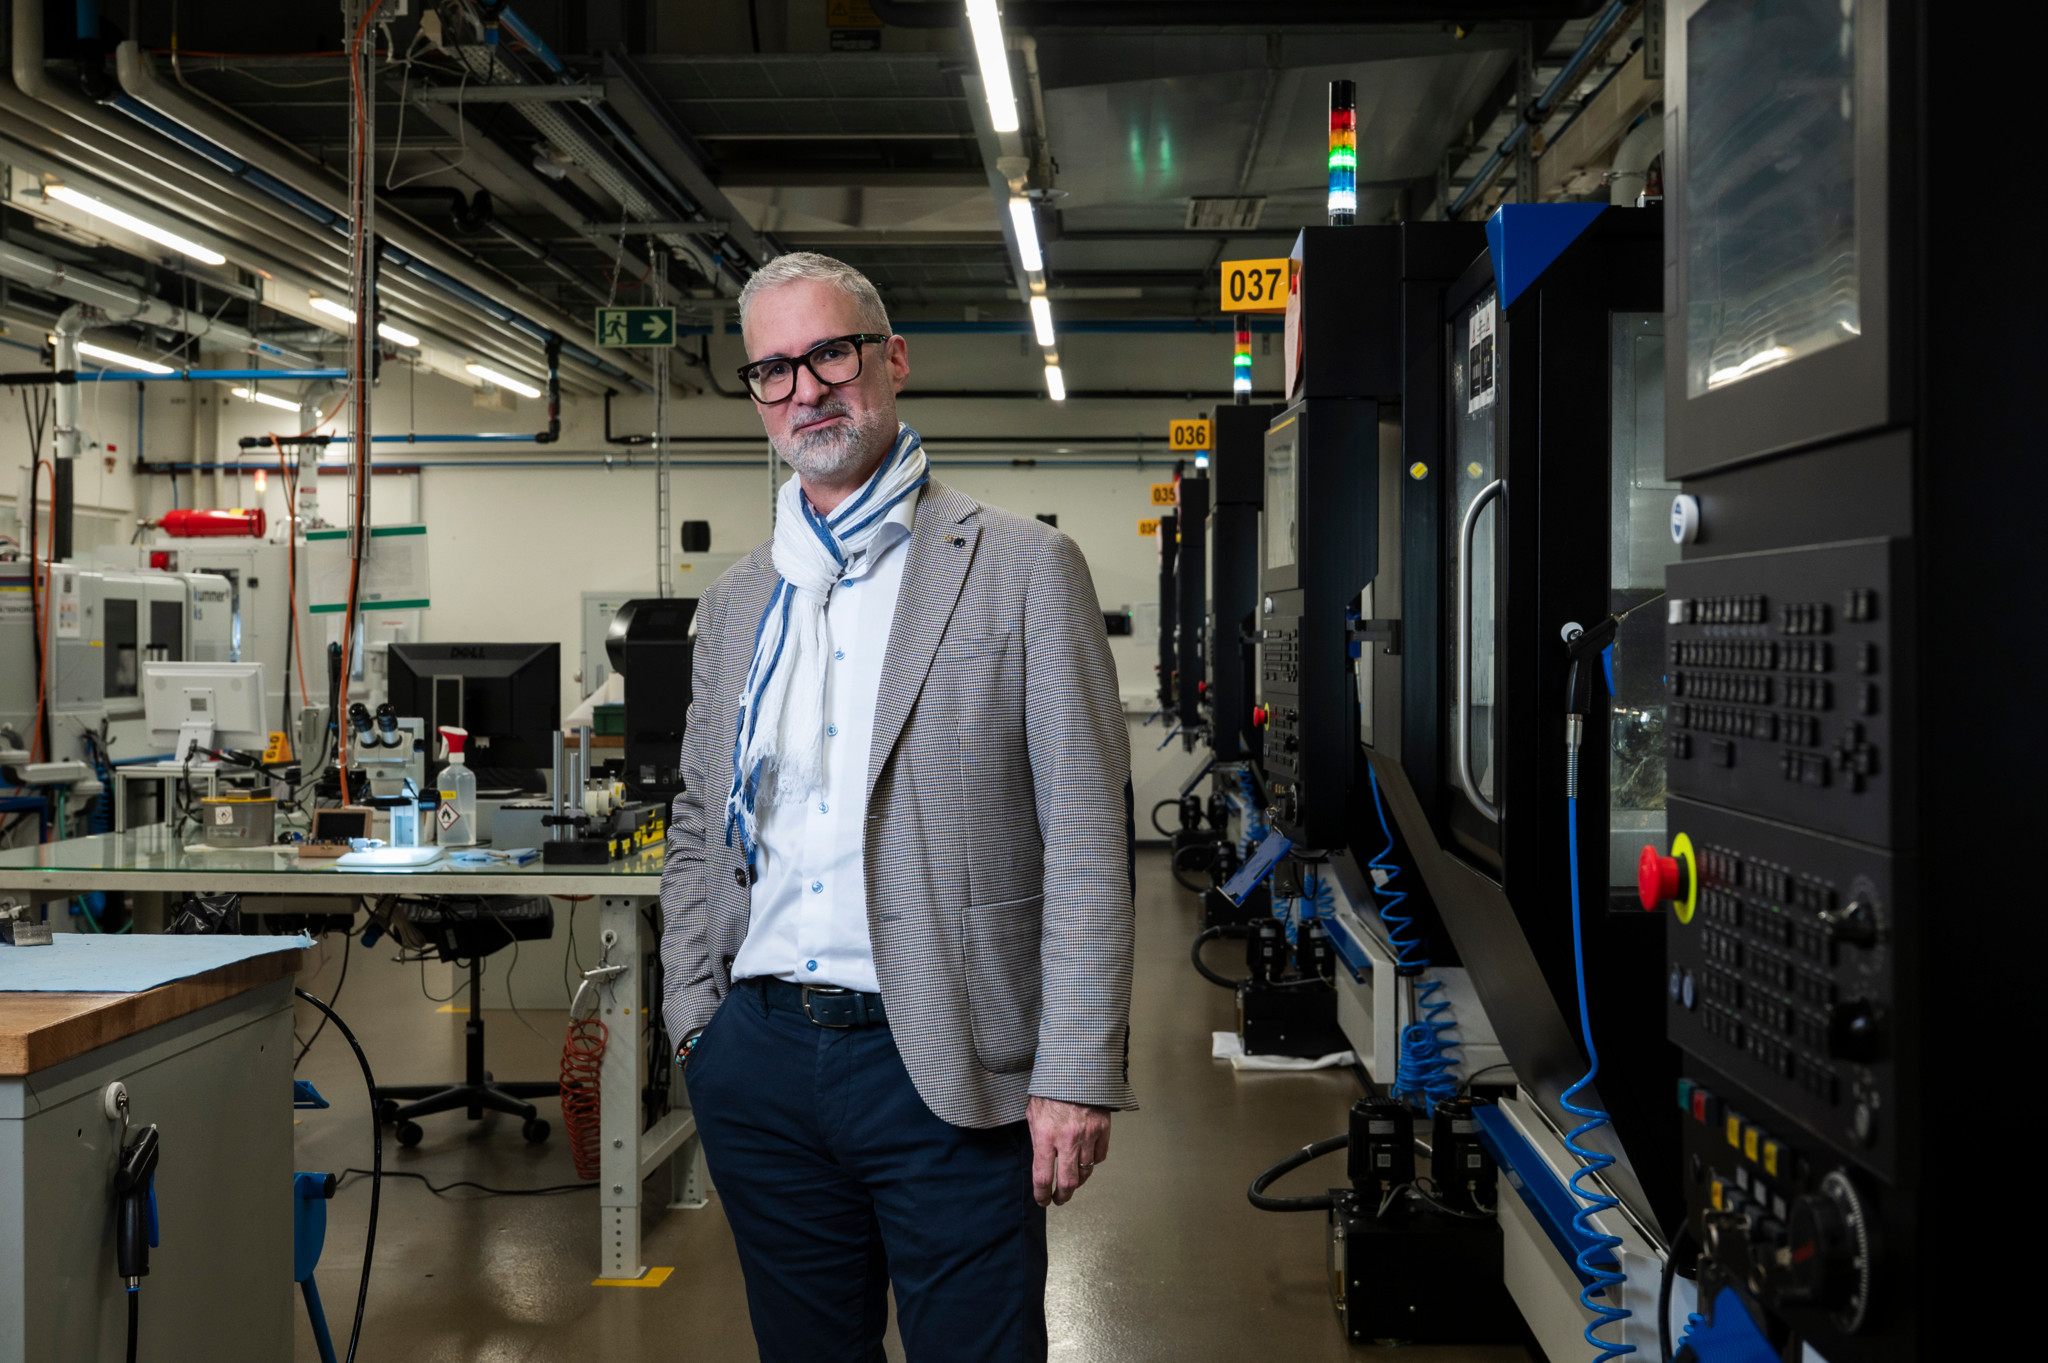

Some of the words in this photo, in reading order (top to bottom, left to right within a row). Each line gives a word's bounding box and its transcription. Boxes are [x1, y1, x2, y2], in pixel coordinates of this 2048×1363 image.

[1230, 268, 1282, 302] 037
[1175, 426, 1206, 445] 036
[1153, 487, 1176, 502] 035
